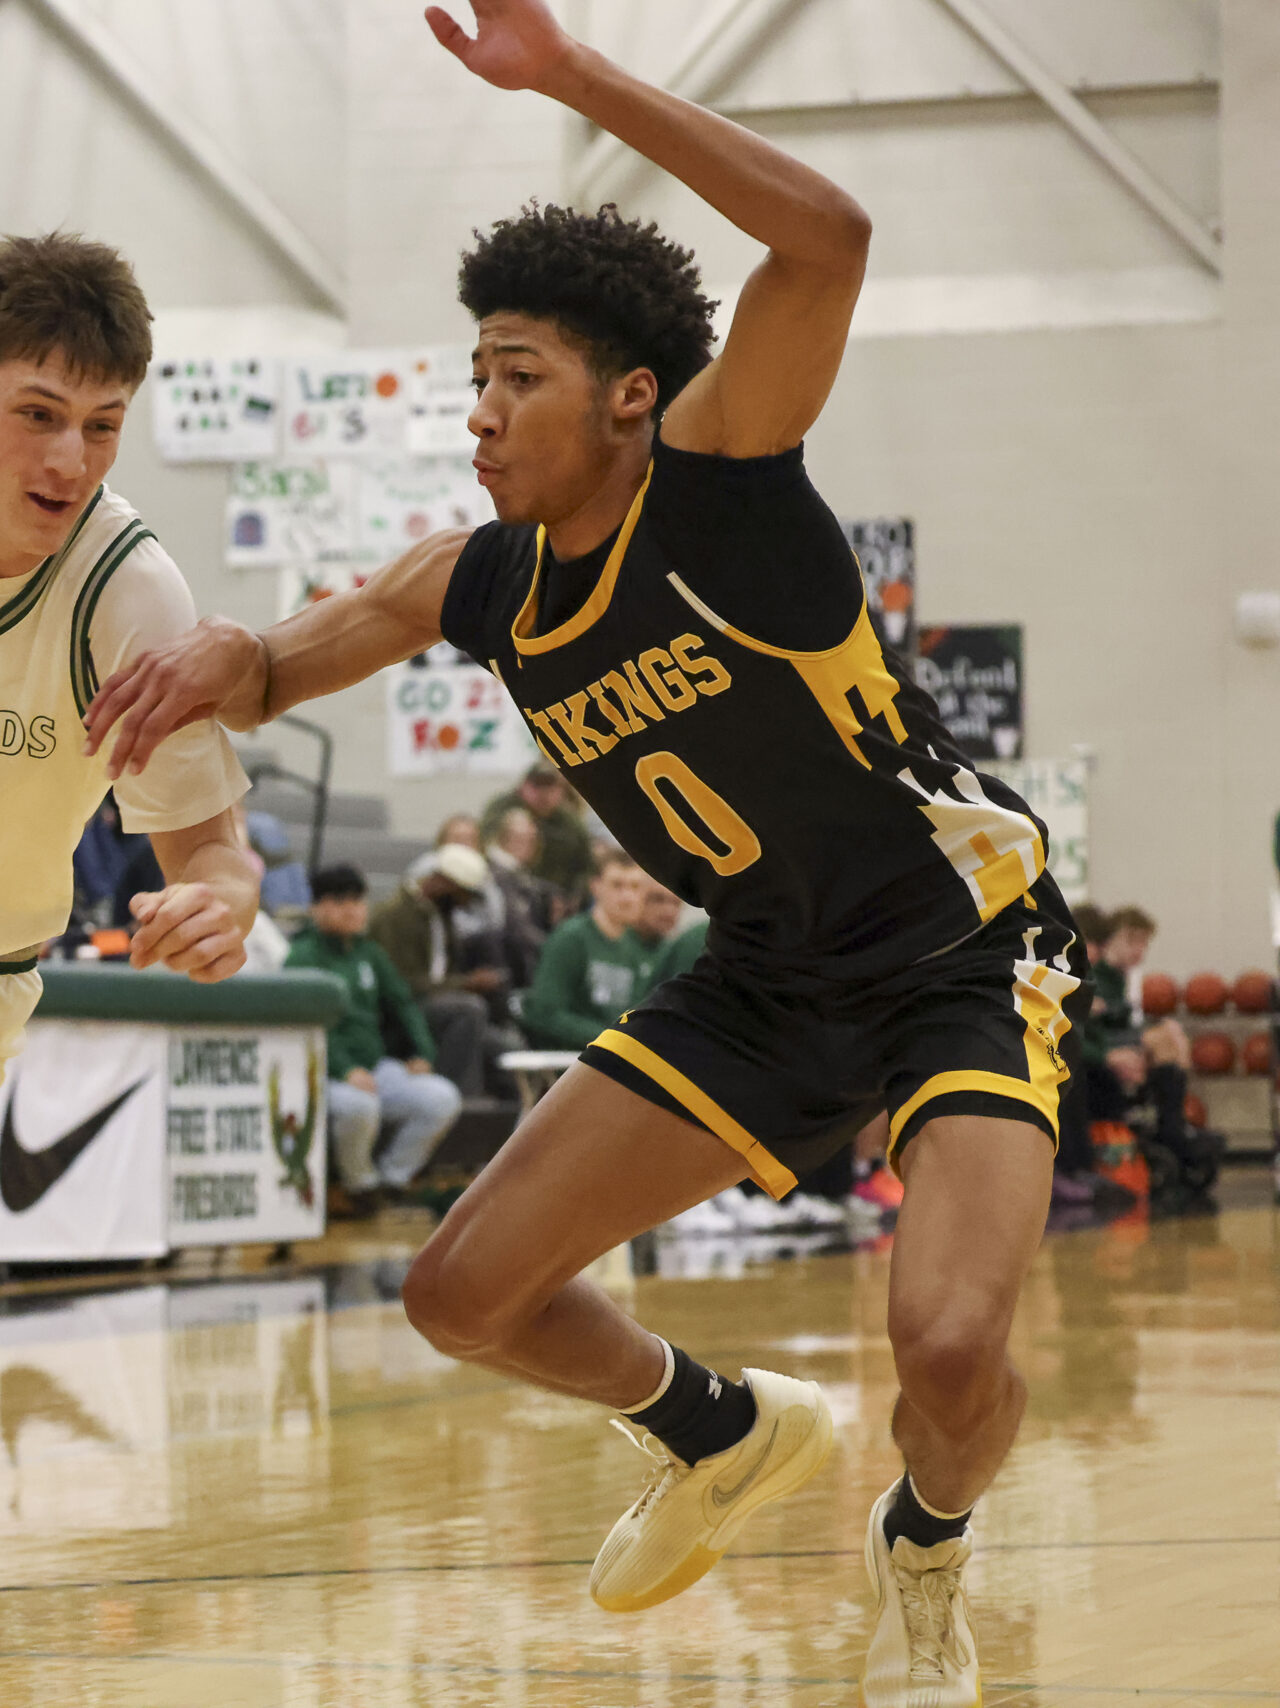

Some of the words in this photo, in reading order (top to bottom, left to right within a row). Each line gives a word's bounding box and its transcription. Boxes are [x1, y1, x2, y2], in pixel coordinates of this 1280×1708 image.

[524, 632, 732, 768] IKINGS
[635, 751, 762, 876] 0
[167, 1107, 207, 1155] FREE
